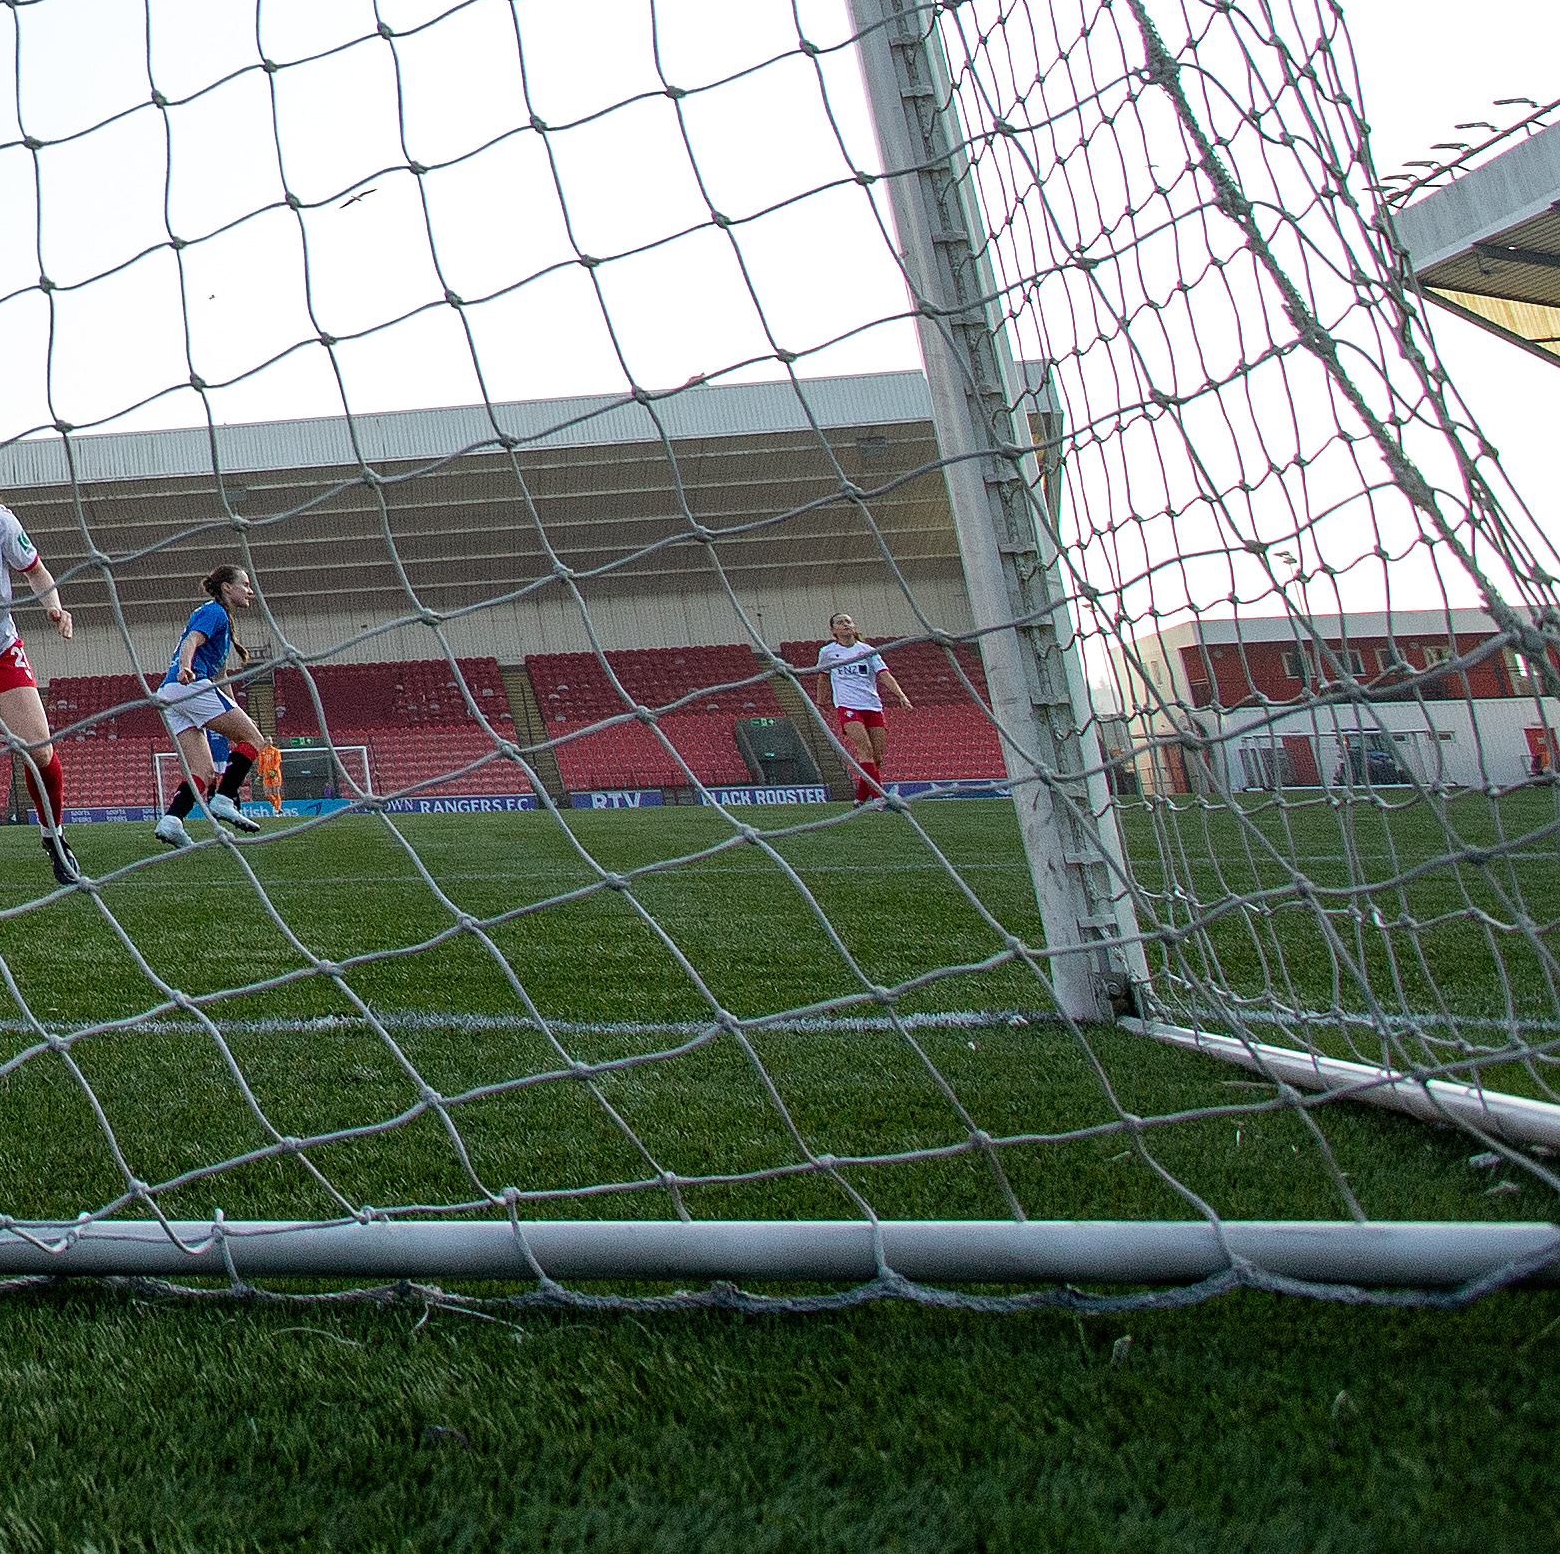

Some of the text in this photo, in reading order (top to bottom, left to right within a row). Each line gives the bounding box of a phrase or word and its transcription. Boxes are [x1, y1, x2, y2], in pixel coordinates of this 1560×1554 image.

[591, 792, 641, 809] RTV
[754, 788, 827, 805] ROOSTER
[420, 798, 503, 813] RANGERS
